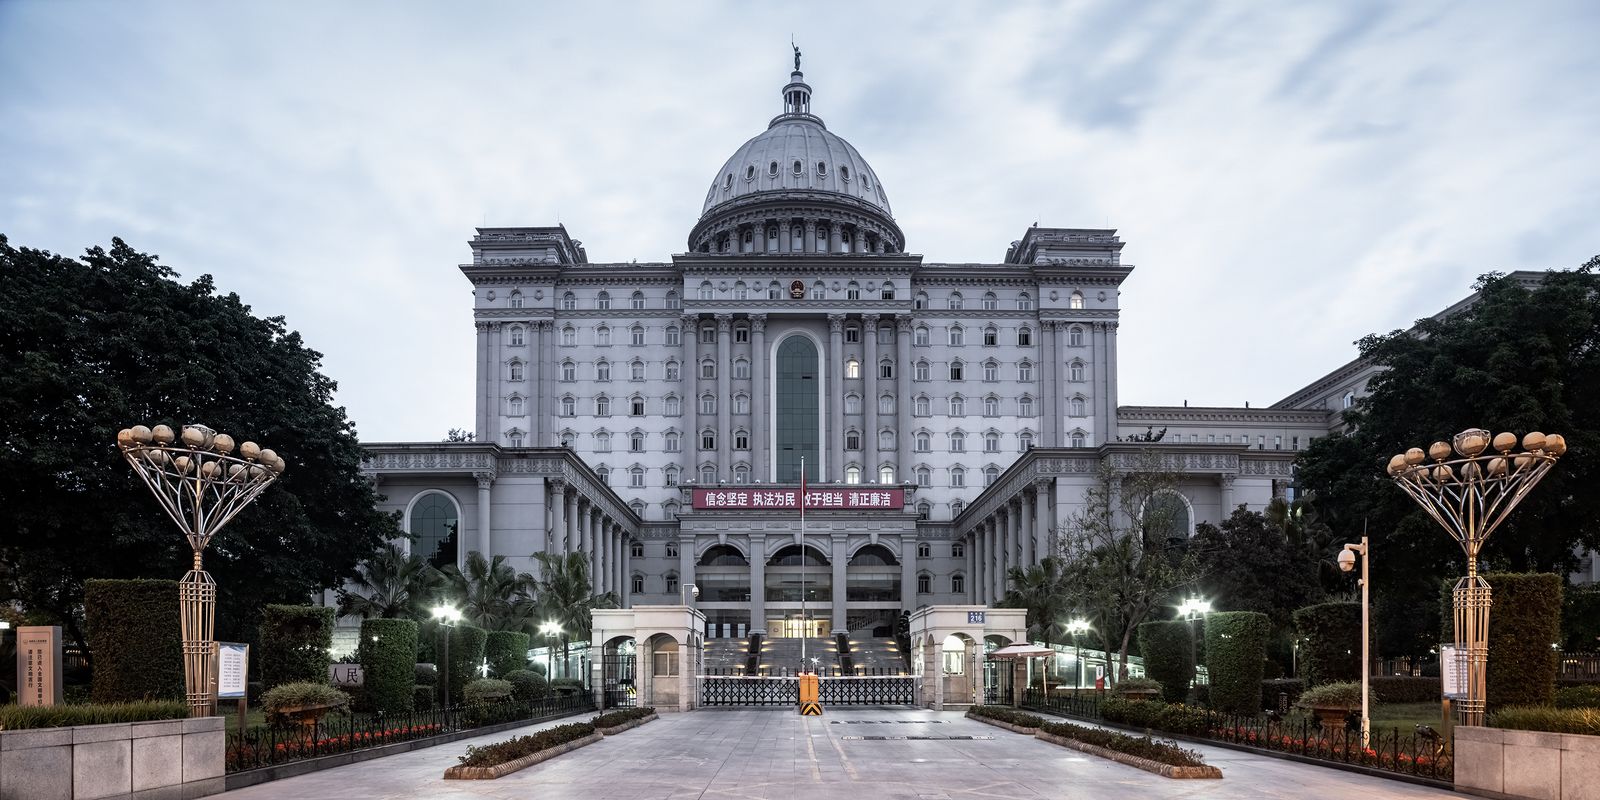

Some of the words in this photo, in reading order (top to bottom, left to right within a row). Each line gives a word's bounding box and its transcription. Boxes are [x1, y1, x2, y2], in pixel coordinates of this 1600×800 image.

[705, 492, 748, 507] 信念坚定
[753, 492, 796, 507] 执法为民
[848, 492, 891, 507] 清正廉洁
[331, 667, 357, 683] 人民
